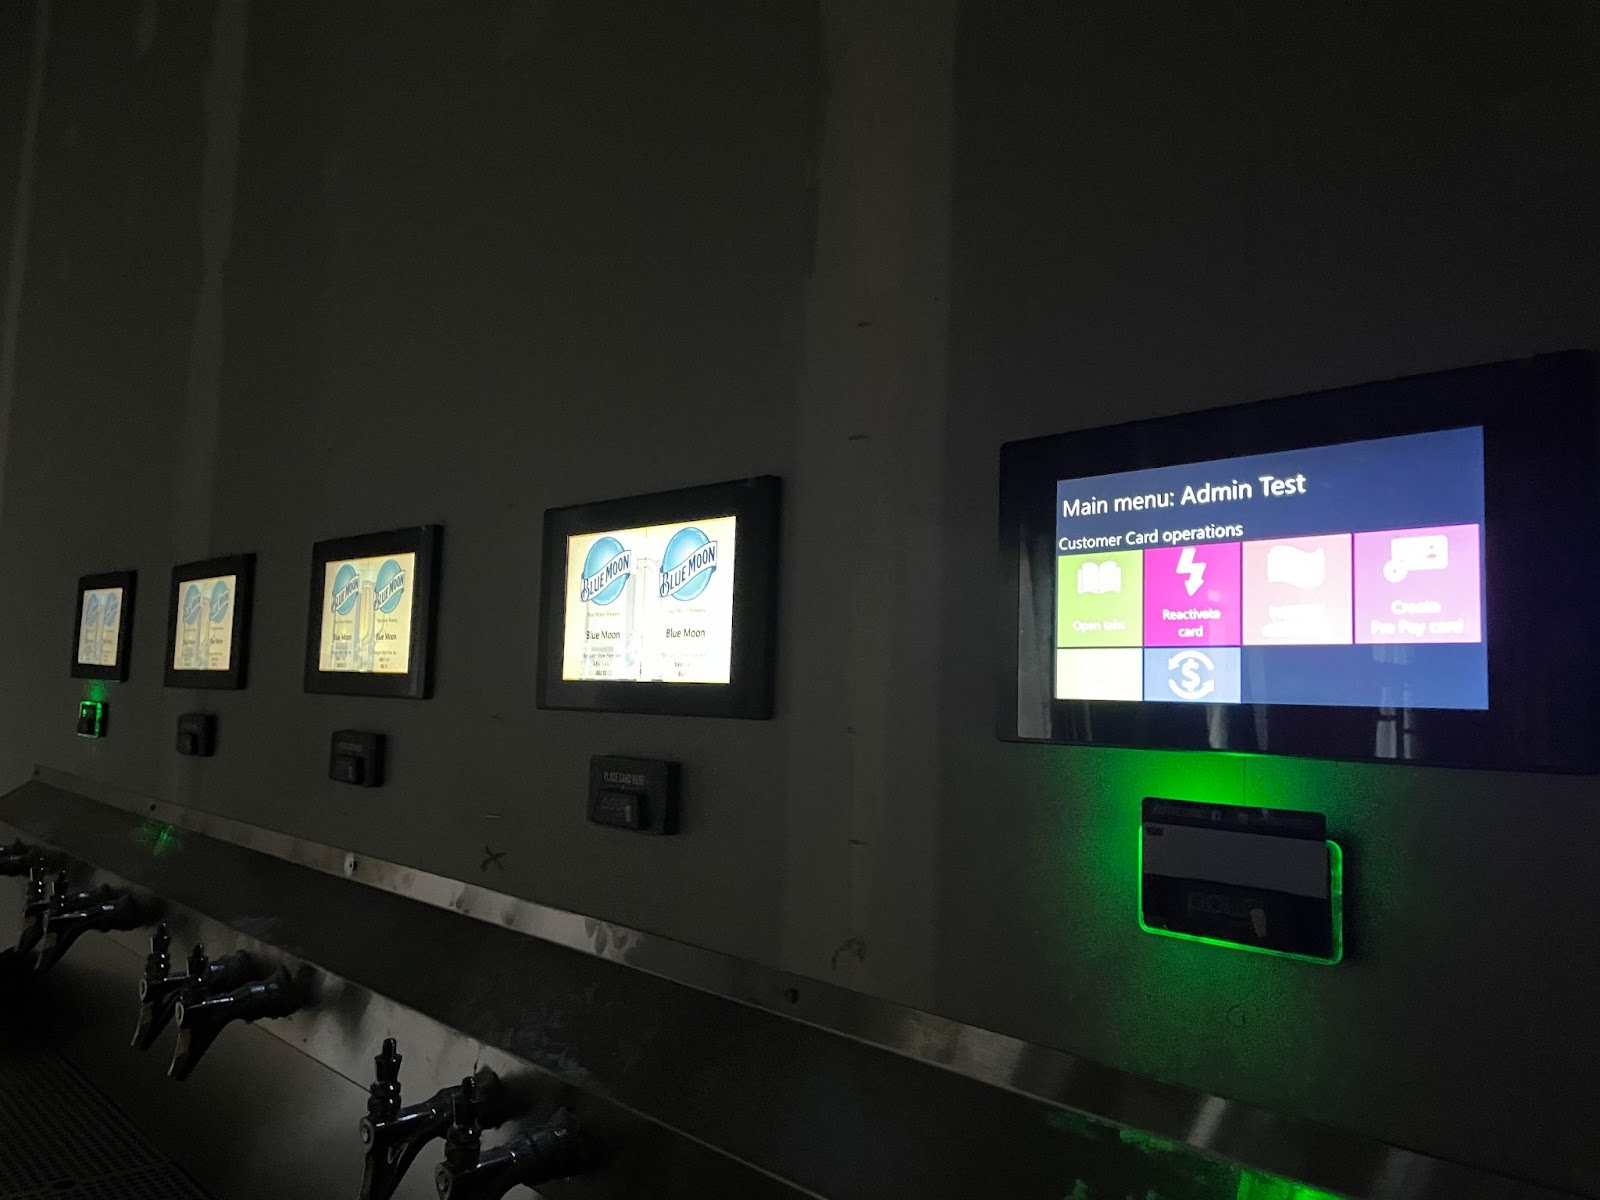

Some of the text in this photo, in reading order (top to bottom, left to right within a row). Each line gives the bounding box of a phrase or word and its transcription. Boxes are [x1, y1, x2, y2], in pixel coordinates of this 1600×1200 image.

[1063, 474, 1307, 517] Main menu: Admin Test
[1059, 522, 1244, 551] Customer Card operations
[581, 553, 630, 602] BLUE MOON
[659, 545, 716, 598] BLUE MOON
[1162, 607, 1221, 621] Reactivate
[586, 630, 621, 640] Blue Moon
[666, 628, 706, 638] Blue Moon
[1178, 625, 1204, 638] card
